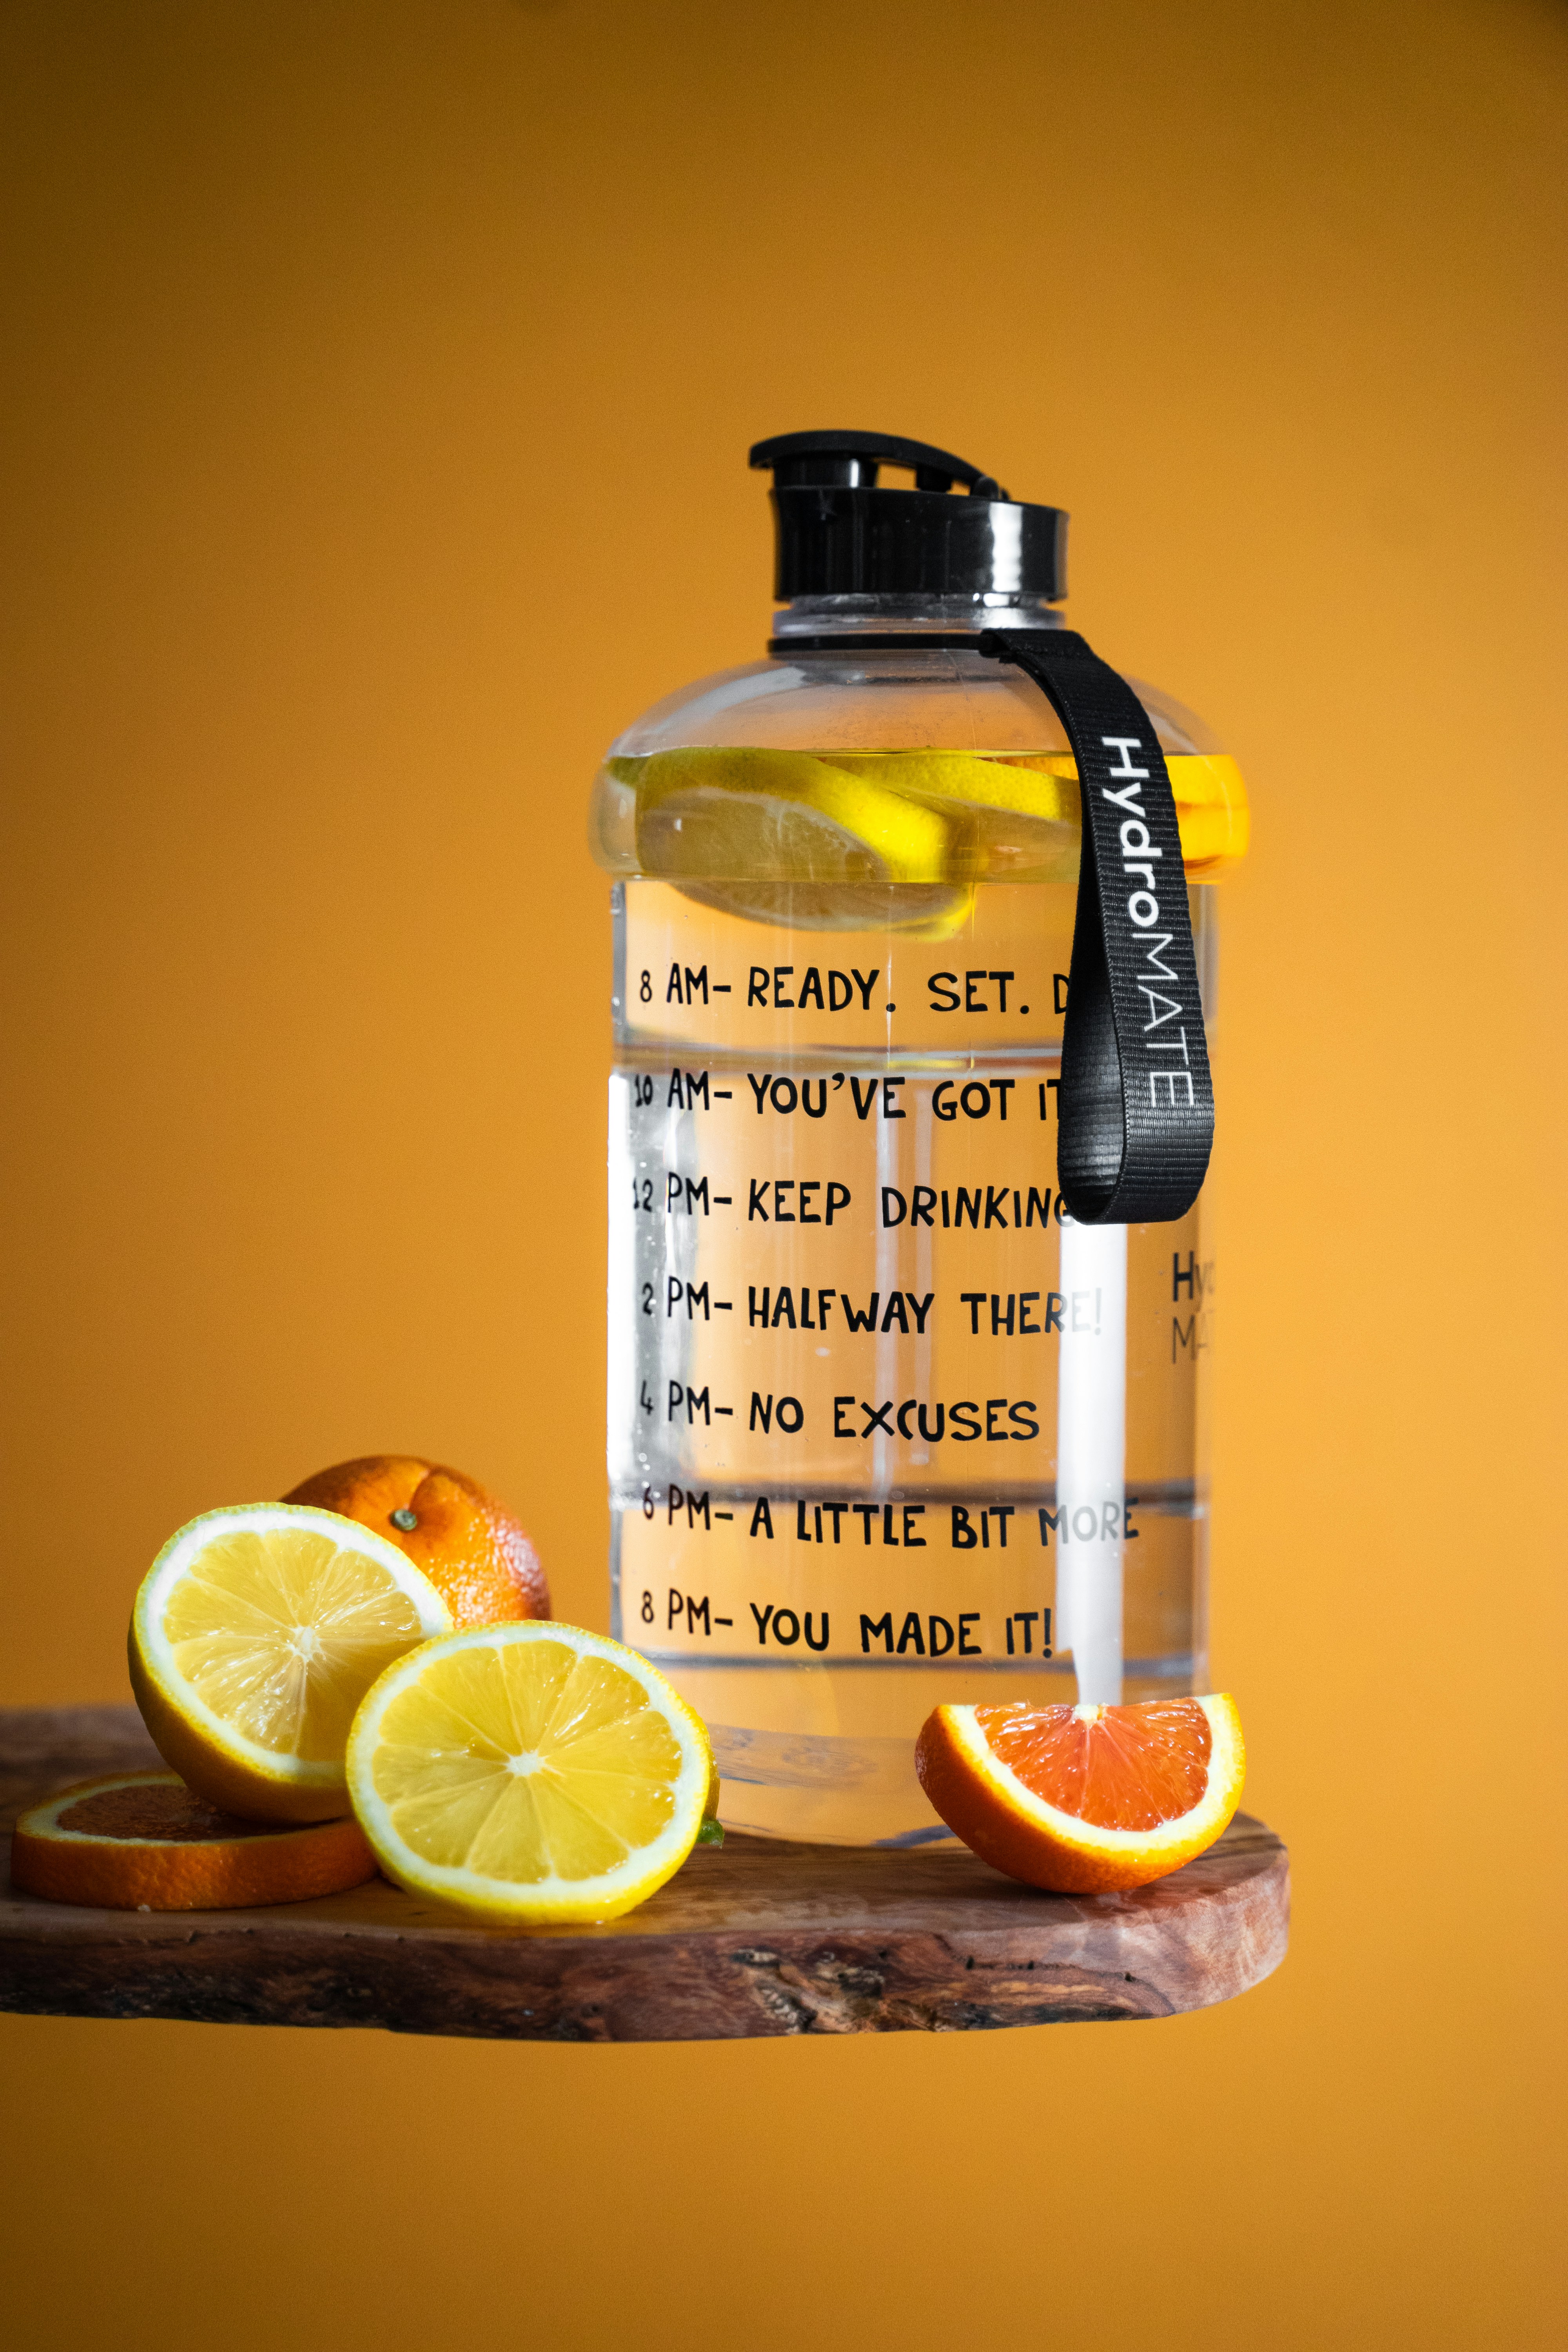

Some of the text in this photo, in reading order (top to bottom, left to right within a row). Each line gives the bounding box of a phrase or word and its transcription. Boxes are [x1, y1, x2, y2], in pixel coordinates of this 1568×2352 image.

[1101, 737, 1194, 1106] HydroMATE
[640, 969, 652, 1002] 8
[666, 963, 731, 1005] AM-
[748, 966, 896, 1013] READY.
[927, 970, 1030, 1014] SET.
[634, 1073, 653, 1107] 10
[667, 1068, 732, 1110] AM-
[747, 1072, 906, 1120] YOU'VE
[931, 1079, 1015, 1121] GOT
[633, 1177, 652, 1212] 12
[668, 1172, 732, 1216] PM-
[748, 1178, 851, 1226] KEEP
[642, 1276, 1102, 1336] 2 PM- HALFWAY THERE!
[641, 1380, 1040, 1443] 4 PM- NO EXCUSES
[643, 1484, 1139, 1549] 6 PM- A LITTLE BIT MORE
[641, 1588, 1053, 1659] 8 PM- YOU MADE IT!
